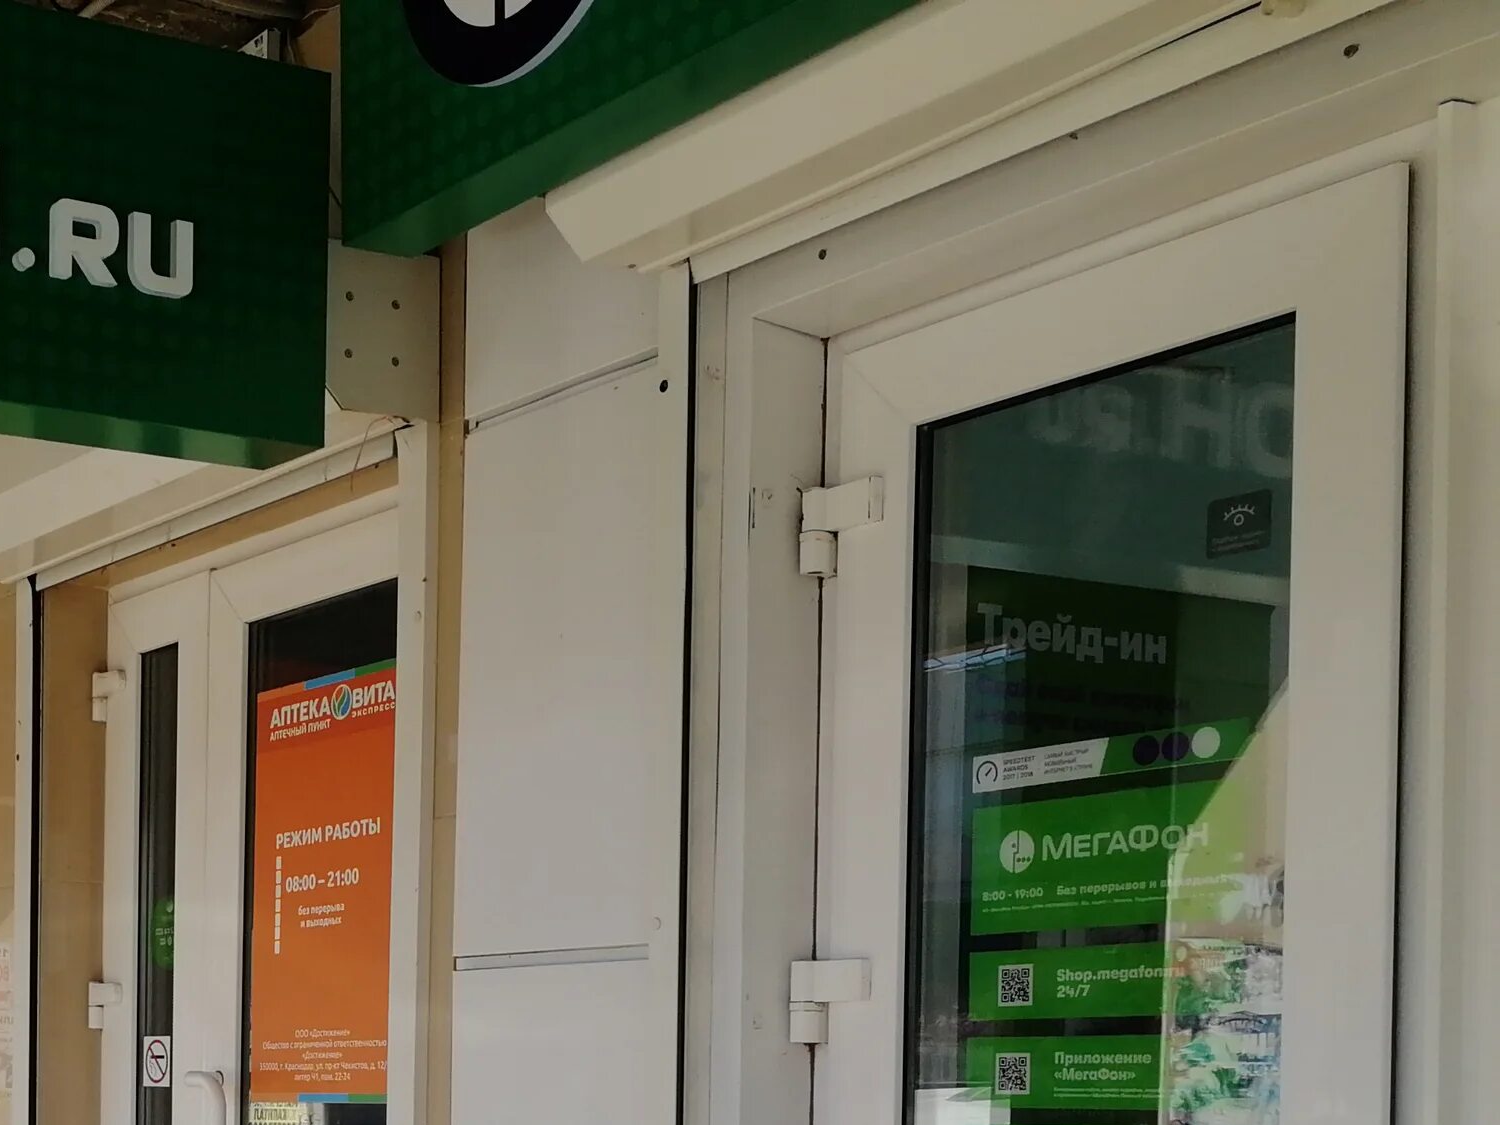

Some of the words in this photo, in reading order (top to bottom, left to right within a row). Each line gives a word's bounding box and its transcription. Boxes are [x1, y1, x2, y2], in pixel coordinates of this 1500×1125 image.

[977, 602, 1167, 664] Трейд-ин
[270, 696, 331, 728] АПТЕКА
[352, 680, 396, 709] ВИТА
[352, 701, 396, 718] ЭКСПРЕСС
[270, 722, 308, 741] АПТЕЧНЫЙ
[308, 719, 331, 733] ПУНКТ
[276, 827, 322, 849] РЕЖИМ
[325, 817, 381, 841] РАБОТЫ
[286, 874, 316, 893] 08:00
[327, 868, 359, 888] 21:00
[982, 890, 1005, 902] 8:00
[1015, 887, 1043, 899] 19:00
[1057, 885, 1077, 897] Без
[1080, 881, 1146, 896] перерывов
[298, 905, 310, 915] без
[311, 903, 345, 914] перерыва
[306, 916, 341, 928] выходных
[1057, 984, 1090, 998] 24/7
[295, 1029, 308, 1038] ООО
[1054, 1051, 1152, 1067] Приложение
[1054, 1067, 1136, 1081] «МегаФон»
